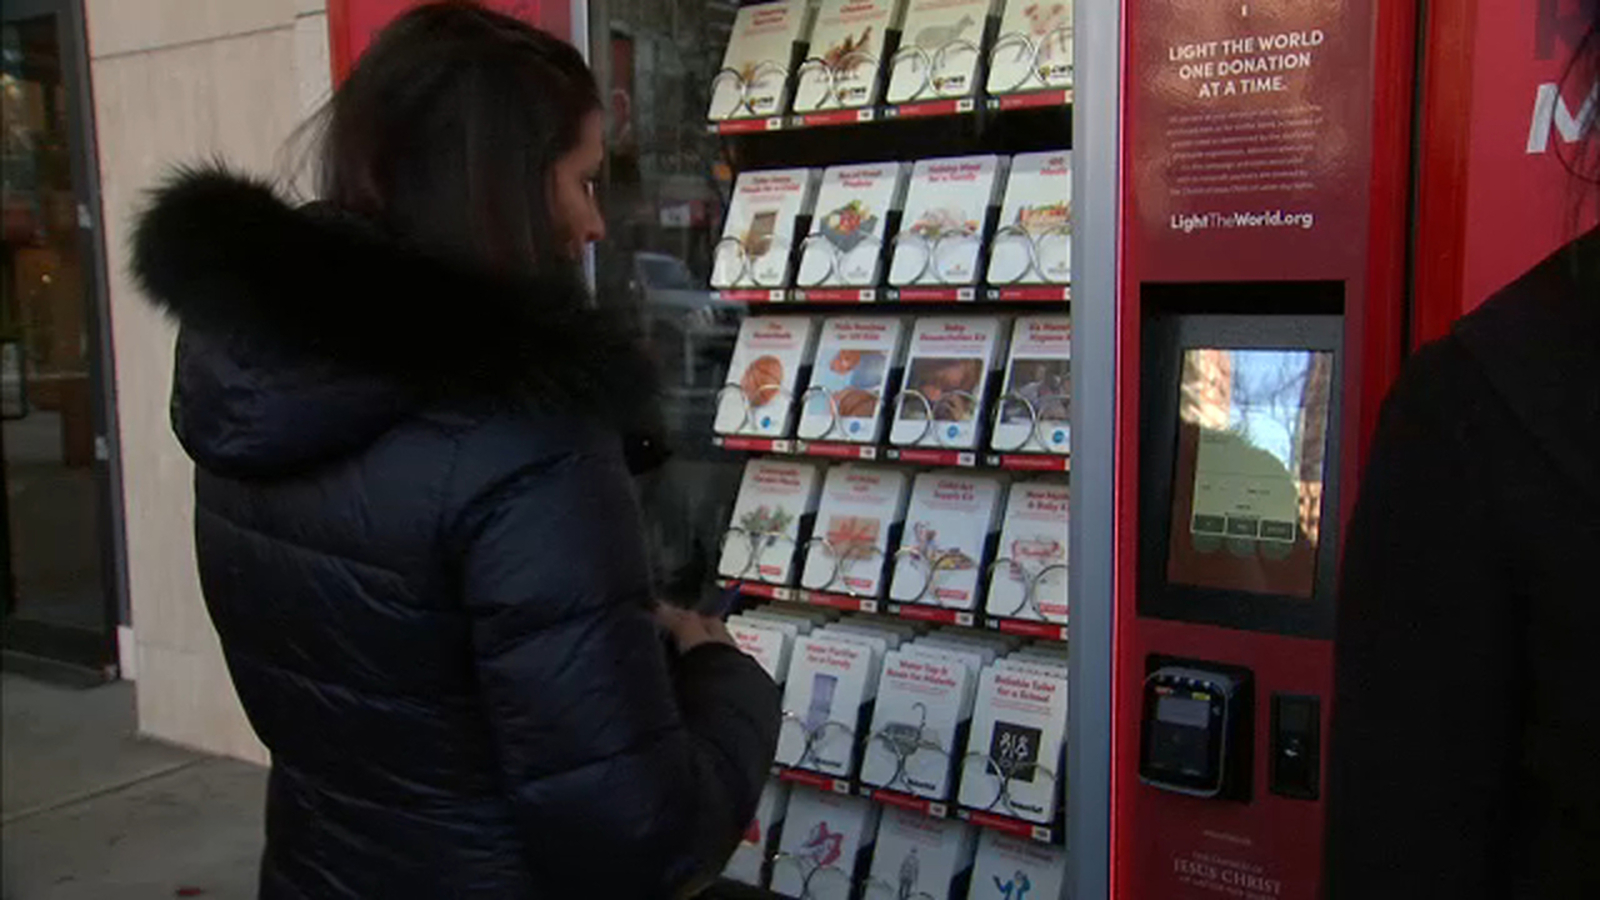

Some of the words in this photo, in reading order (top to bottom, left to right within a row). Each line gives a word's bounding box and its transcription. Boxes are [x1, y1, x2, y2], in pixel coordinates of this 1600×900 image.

[1169, 42, 1218, 61] LIGHT
[1222, 37, 1254, 55] THE
[1258, 29, 1324, 51] WORLD
[1179, 62, 1214, 79] ONE
[1218, 52, 1311, 75] DONATION
[1198, 82, 1223, 98] AT
[1224, 81, 1236, 95] A
[1239, 76, 1289, 93] TIME.
[1170, 210, 1314, 232] LightTheWorld.org
[1174, 858, 1217, 880] JESUS
[1221, 868, 1281, 895] CHRIST
